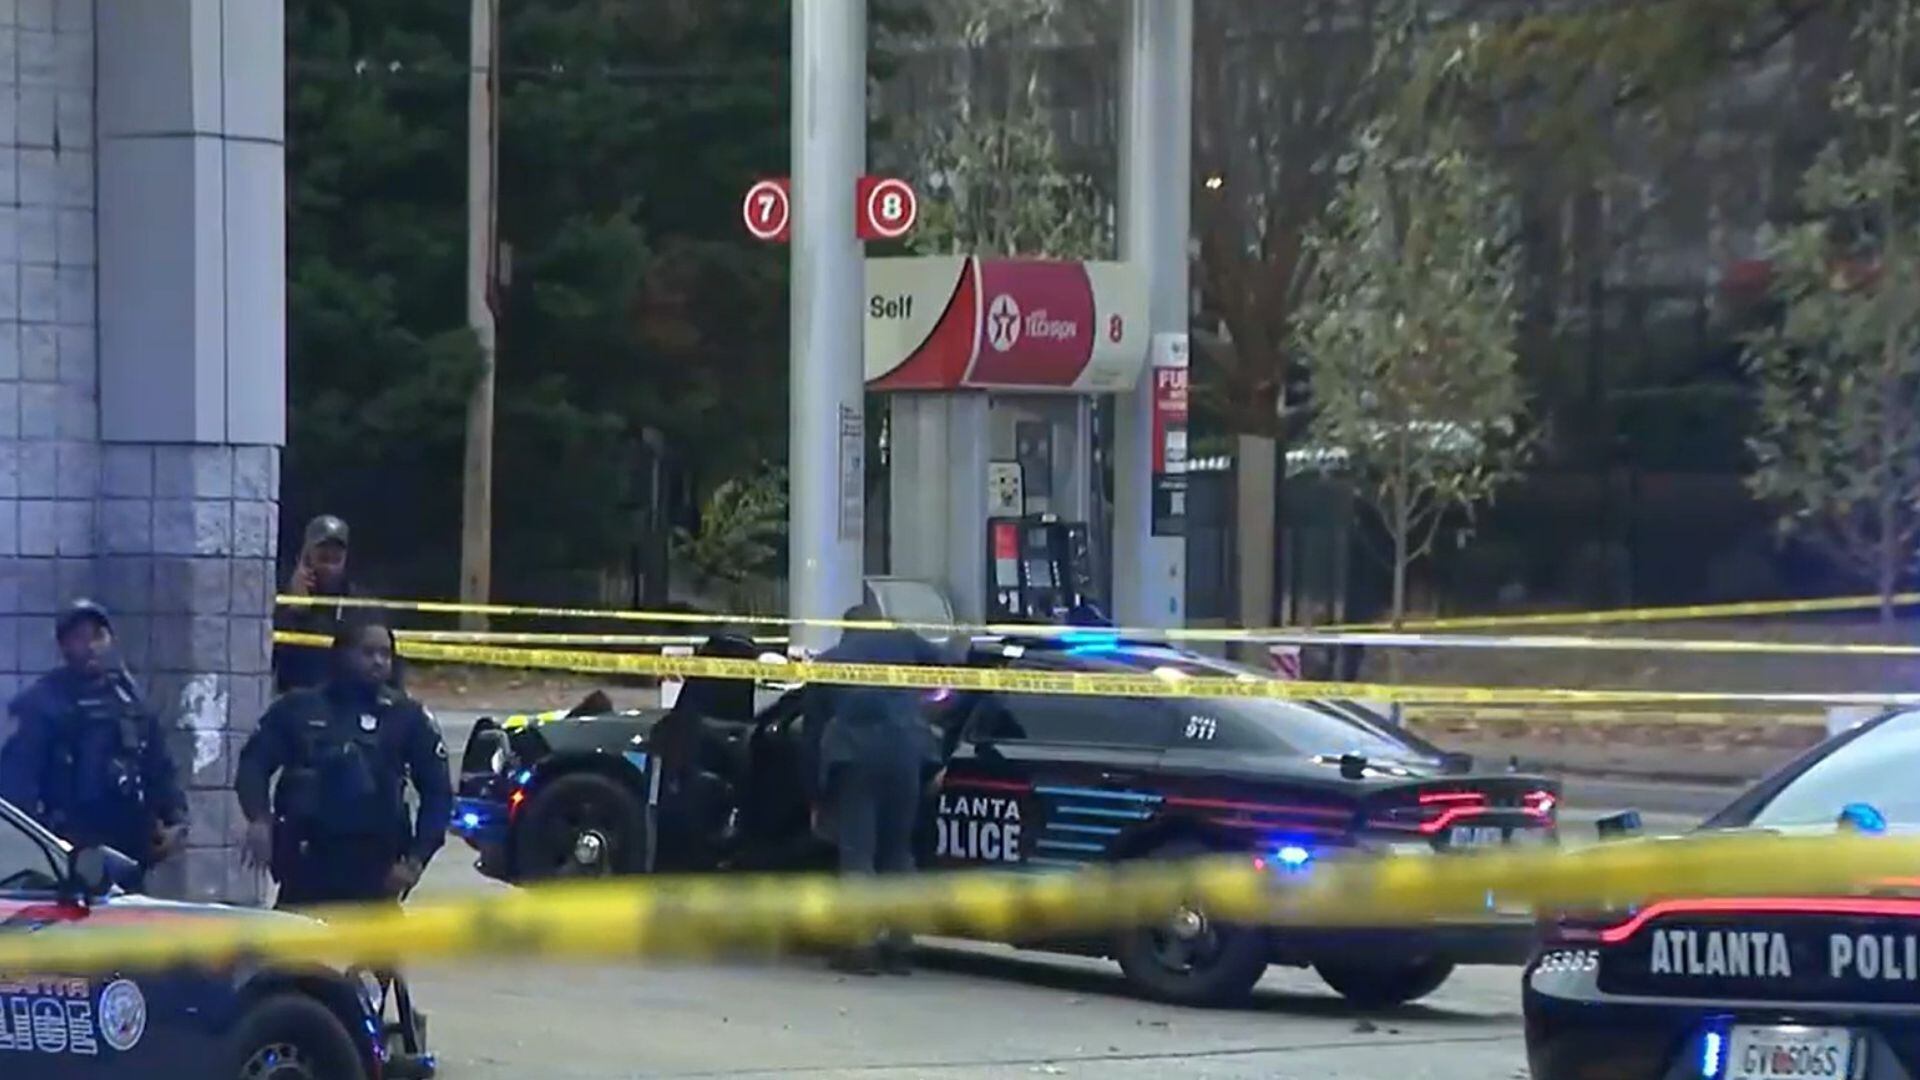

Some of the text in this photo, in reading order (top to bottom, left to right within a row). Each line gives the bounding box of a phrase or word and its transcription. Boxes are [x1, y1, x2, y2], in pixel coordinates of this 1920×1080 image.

[757, 193, 775, 223] 7
[881, 192, 902, 221] 8
[869, 295, 913, 319] Self
[1109, 313, 1123, 343] 8
[1186, 723, 1215, 740] 911
[938, 794, 1020, 820] LANTA
[936, 817, 1021, 861] LICE
[1651, 929, 1919, 980] ATLANTA POLI
[0, 996, 98, 1055] LICE
